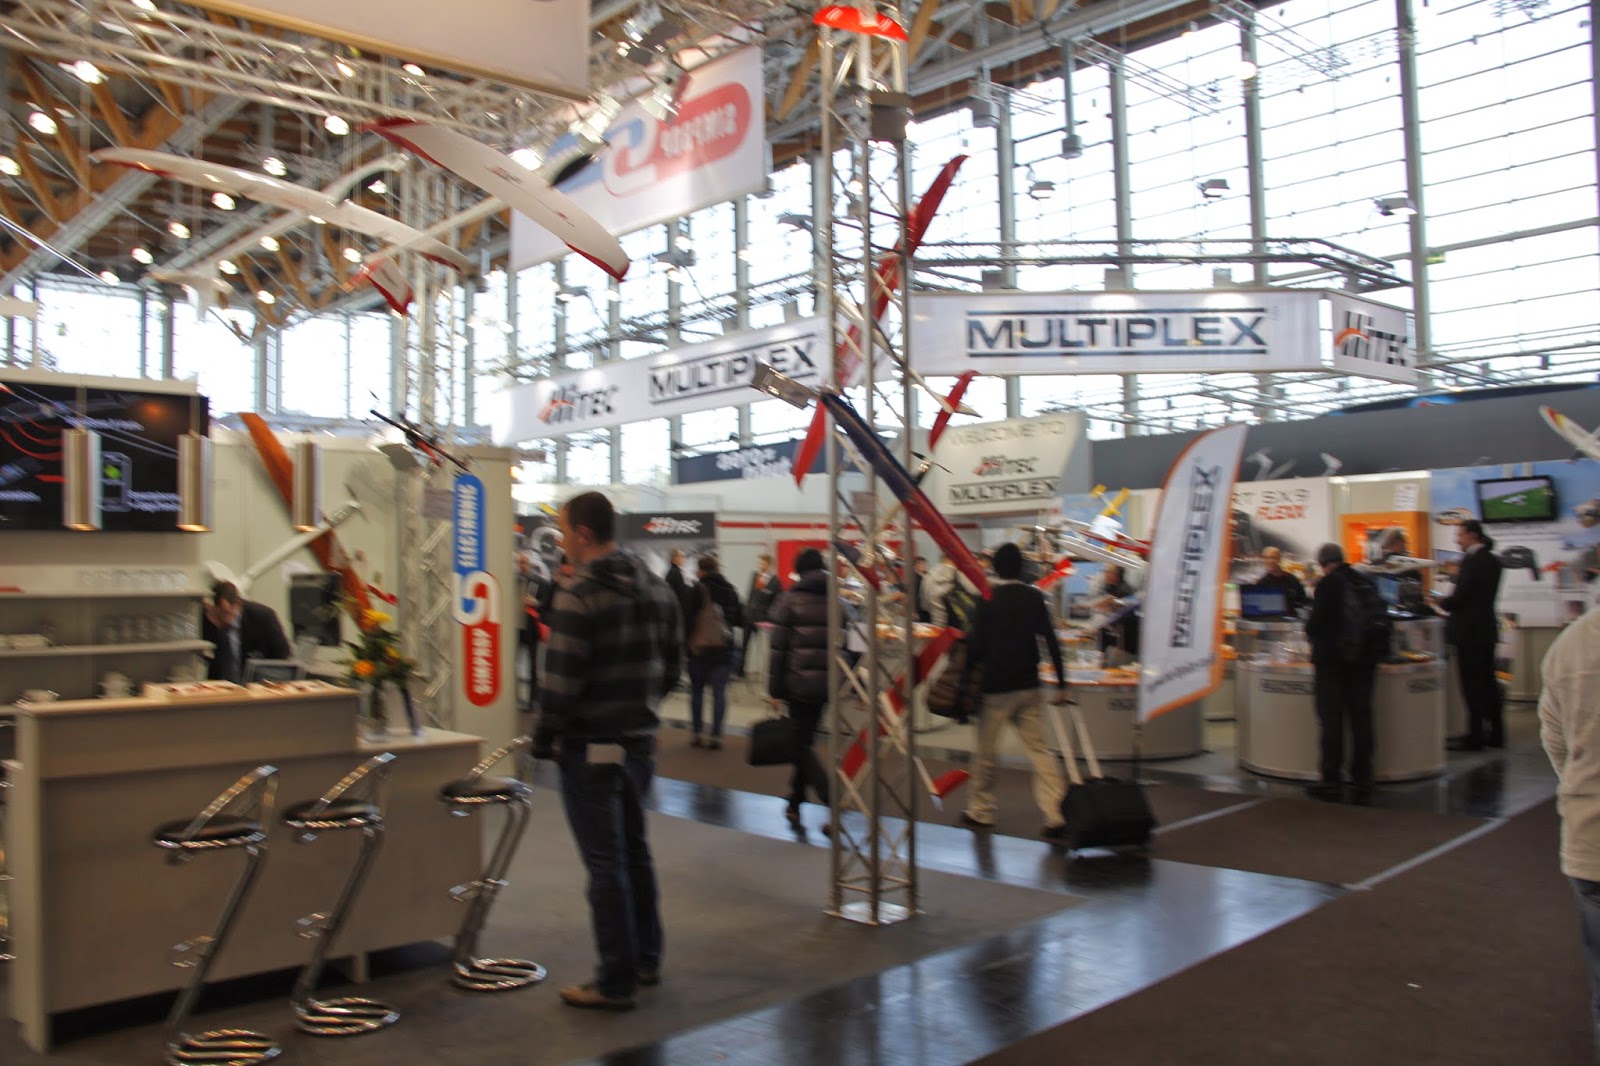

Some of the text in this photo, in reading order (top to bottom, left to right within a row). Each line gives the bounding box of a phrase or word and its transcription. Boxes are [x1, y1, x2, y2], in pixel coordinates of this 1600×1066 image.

[967, 313, 1268, 351] MULTIPLEX
[457, 483, 478, 568] ELECTRONIC
[948, 479, 1058, 503] MULTIPLEX
[1171, 466, 1220, 649] MULTIPLEX
[471, 627, 494, 696] SIMPROP
